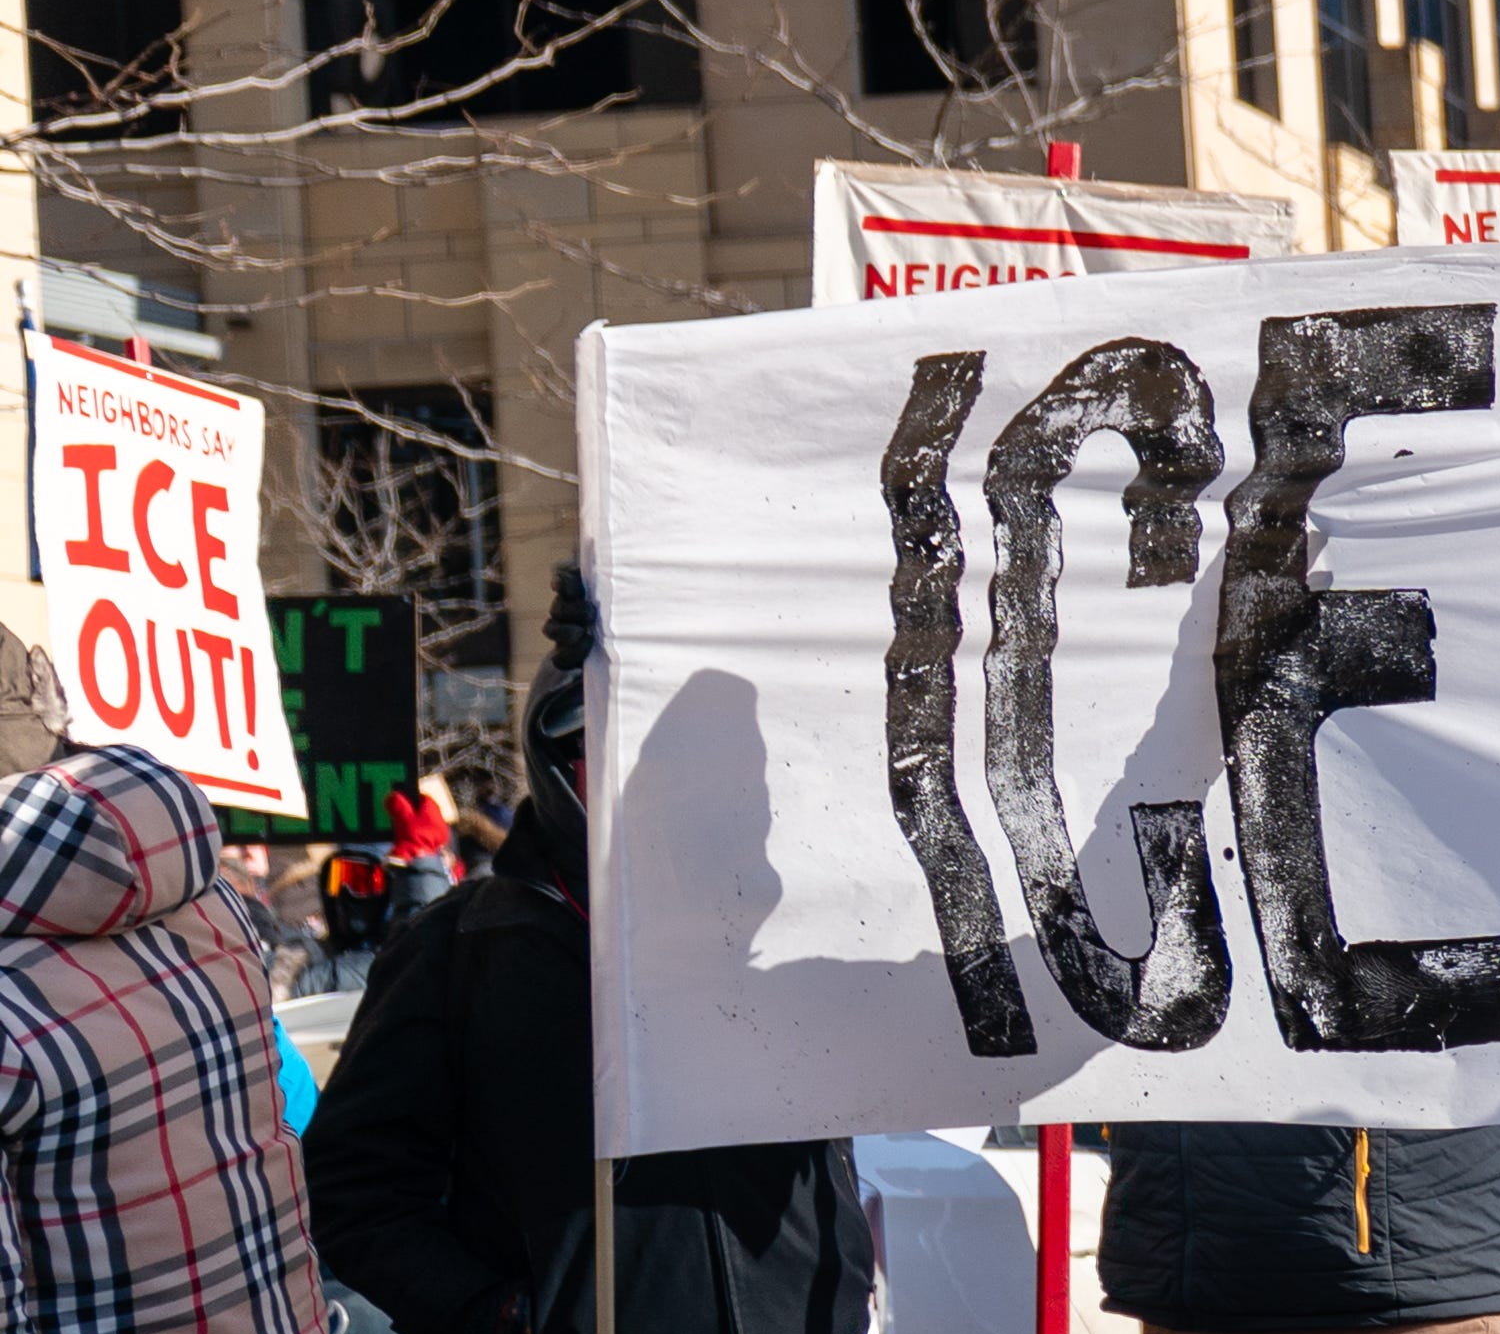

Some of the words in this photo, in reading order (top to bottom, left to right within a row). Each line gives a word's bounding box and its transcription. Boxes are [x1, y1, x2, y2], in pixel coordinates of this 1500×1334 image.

[57, 381, 193, 450] NEIGHBORS
[201, 426, 236, 466] SAY
[62, 443, 240, 621] ICE
[77, 597, 260, 772] OUT!
